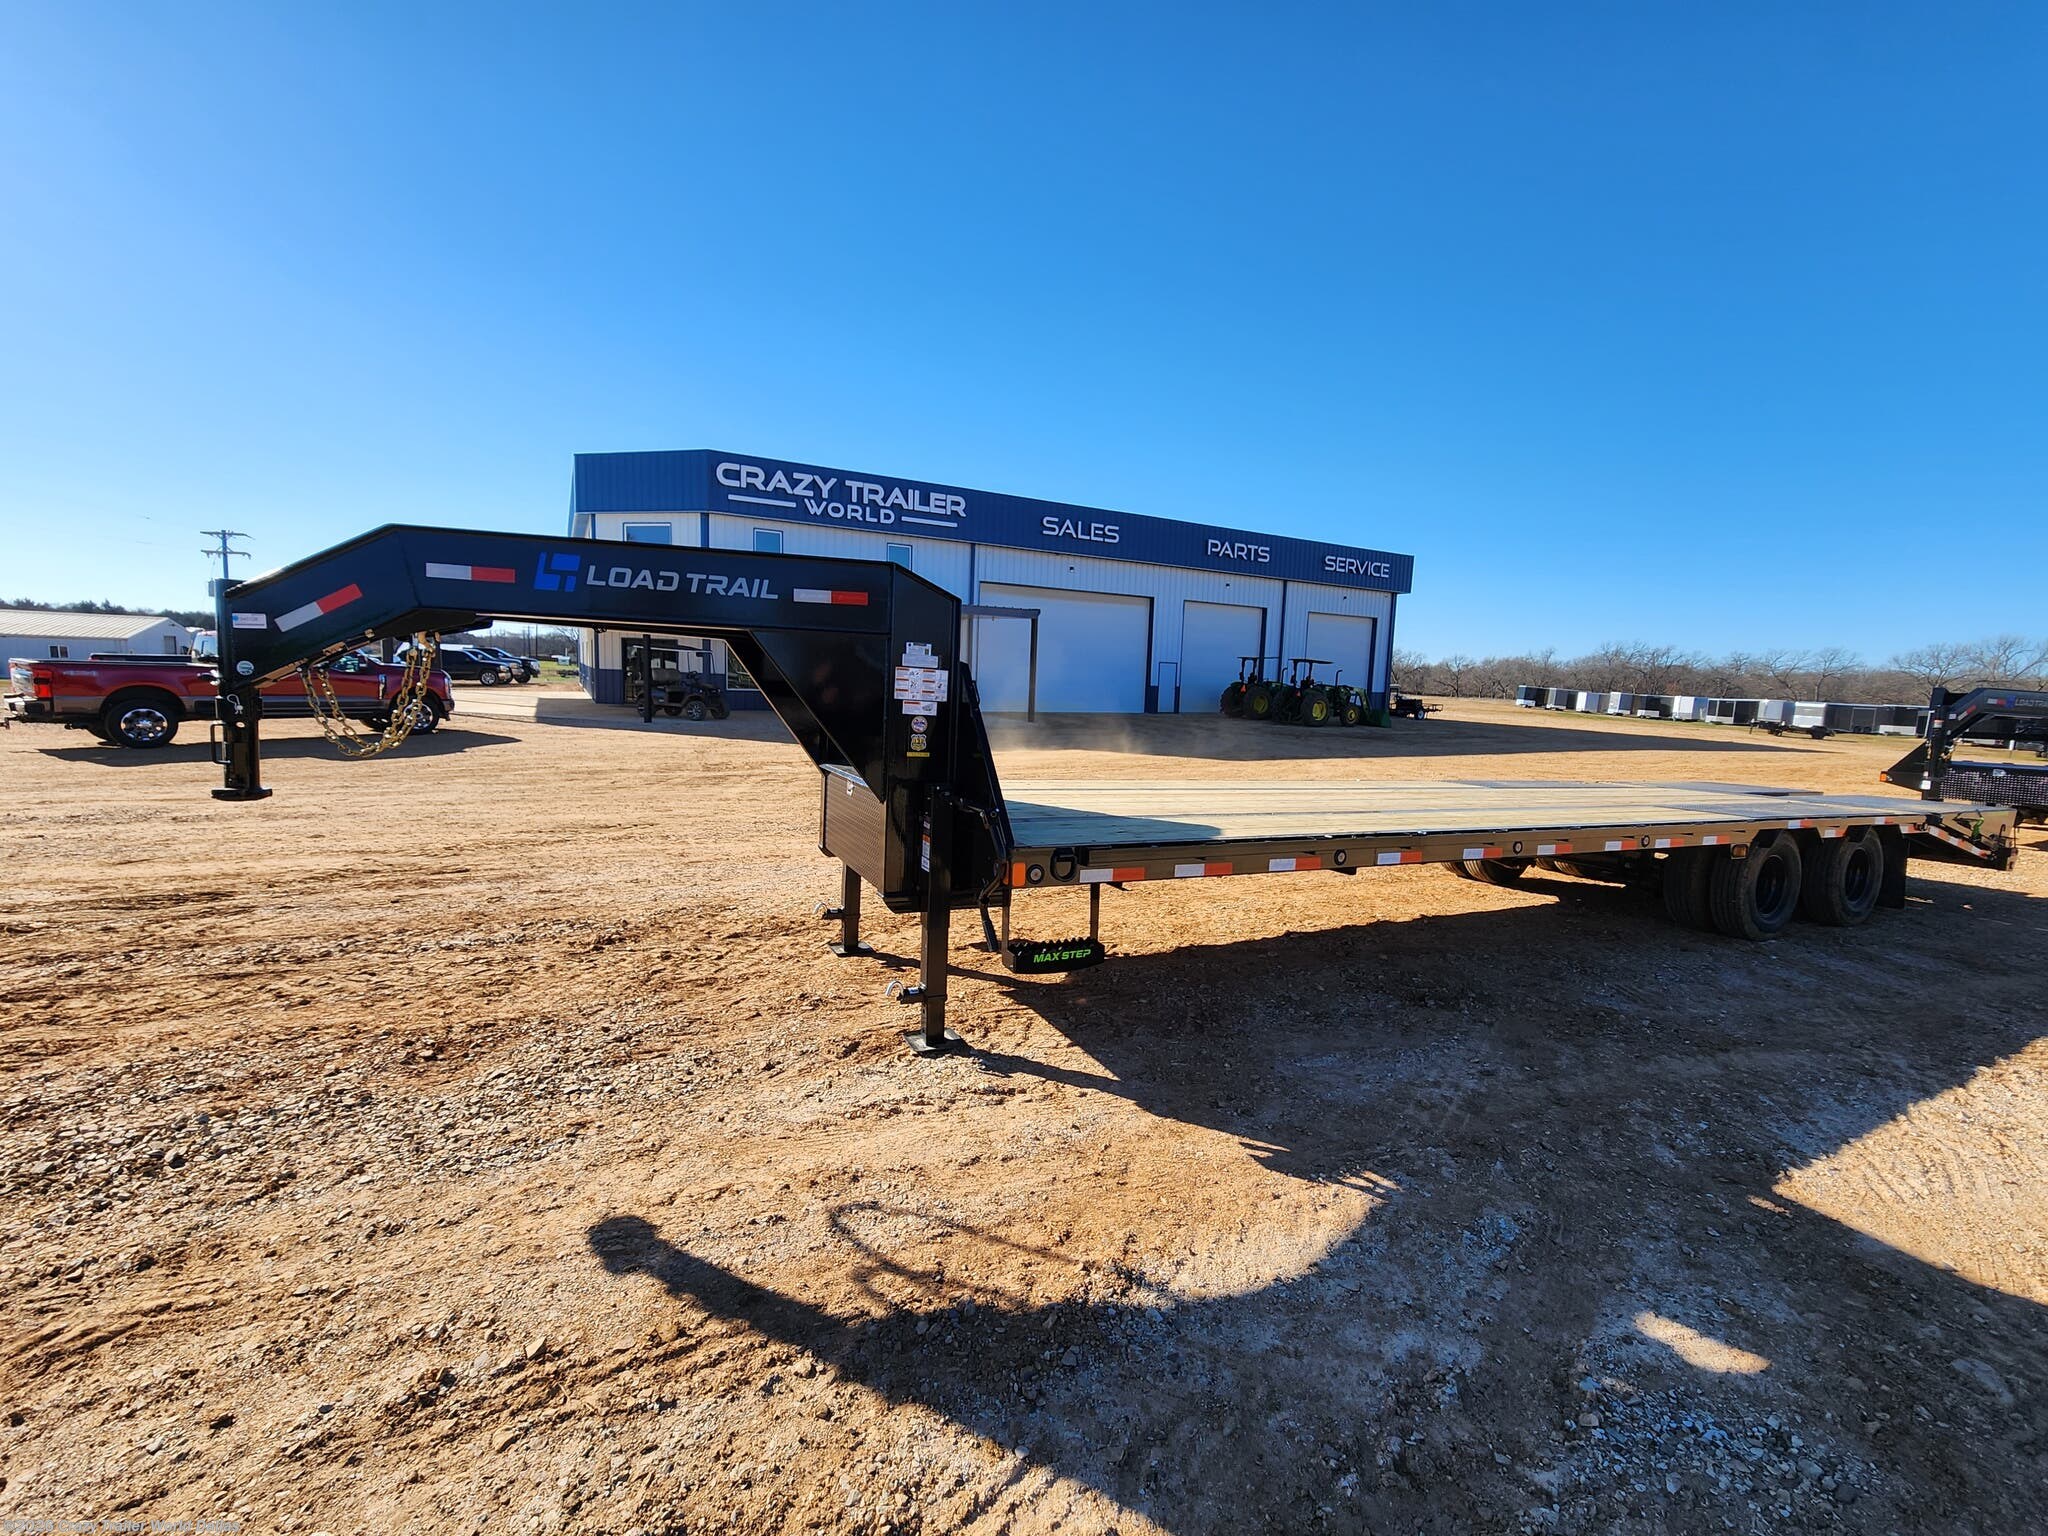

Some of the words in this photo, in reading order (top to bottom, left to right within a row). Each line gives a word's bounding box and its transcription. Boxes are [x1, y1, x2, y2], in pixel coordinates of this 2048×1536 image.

[716, 462, 837, 498] CRAZY
[845, 479, 966, 517] TRAILER
[804, 498, 895, 525] WORLD
[1042, 516, 1120, 543] SALES
[1207, 539, 1270, 563] PARTS
[1324, 555, 1390, 578] SERVICE
[586, 564, 679, 591] LOAD
[686, 572, 779, 600] TRAIL
[1033, 952, 1060, 963] MAX
[1061, 949, 1091, 960] STEP
